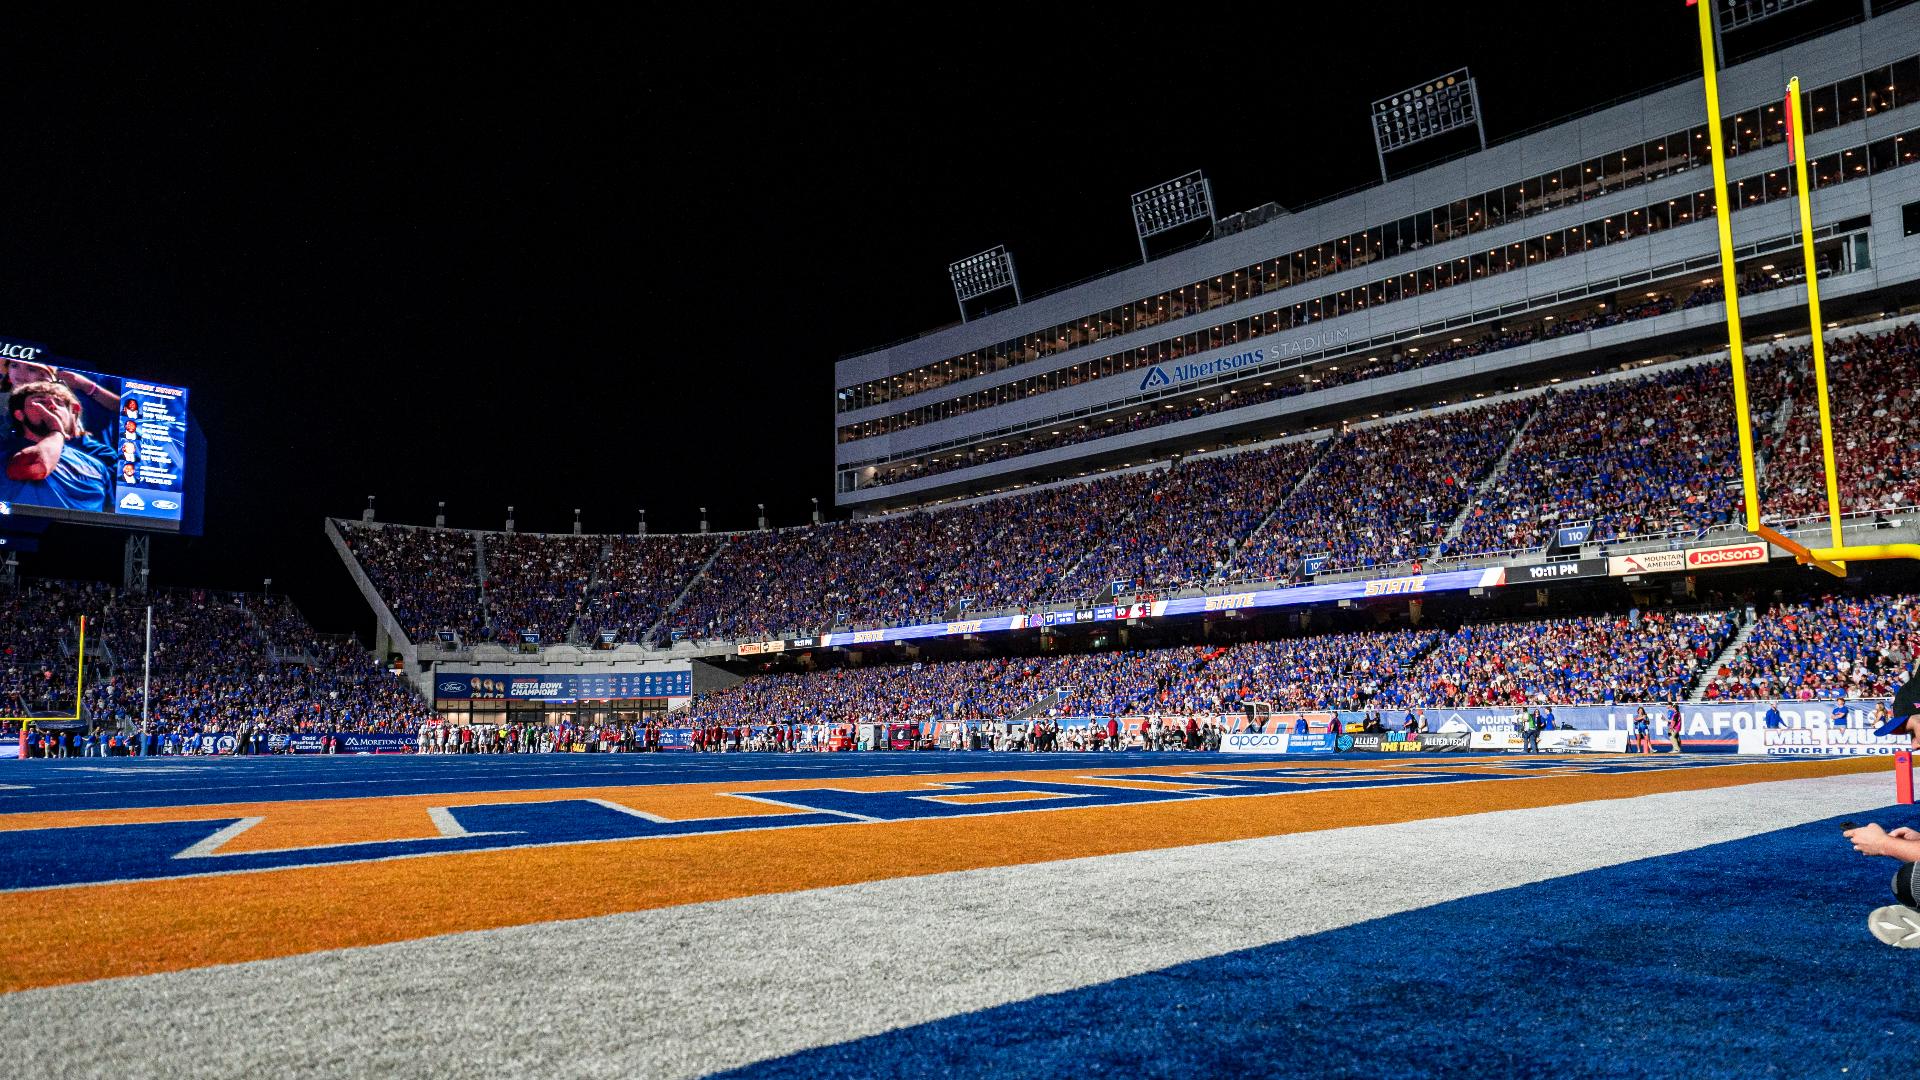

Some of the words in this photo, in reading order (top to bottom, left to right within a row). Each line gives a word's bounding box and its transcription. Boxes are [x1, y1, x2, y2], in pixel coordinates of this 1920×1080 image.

[1172, 349, 1264, 384] Albertsons
[1270, 327, 1350, 359] STADIUM
[1568, 531, 1583, 541] 110
[1644, 553, 1684, 562] MOUNTAIN
[1694, 548, 1760, 565] Jacksons
[1529, 566, 1557, 578] 10:11
[1559, 563, 1578, 576] PM
[1647, 560, 1682, 569] AMERICA
[1364, 576, 1428, 596] STATE
[1205, 592, 1256, 611] STATE
[1116, 608, 1126, 616] 10
[947, 619, 983, 635] STATE
[853, 629, 885, 644] STATE
[510, 688, 559, 696] CHAMPIONS
[360, 738, 397, 746] MORETON
[1354, 737, 1379, 745] ALLIED
[1764, 729, 1821, 746] MR.
